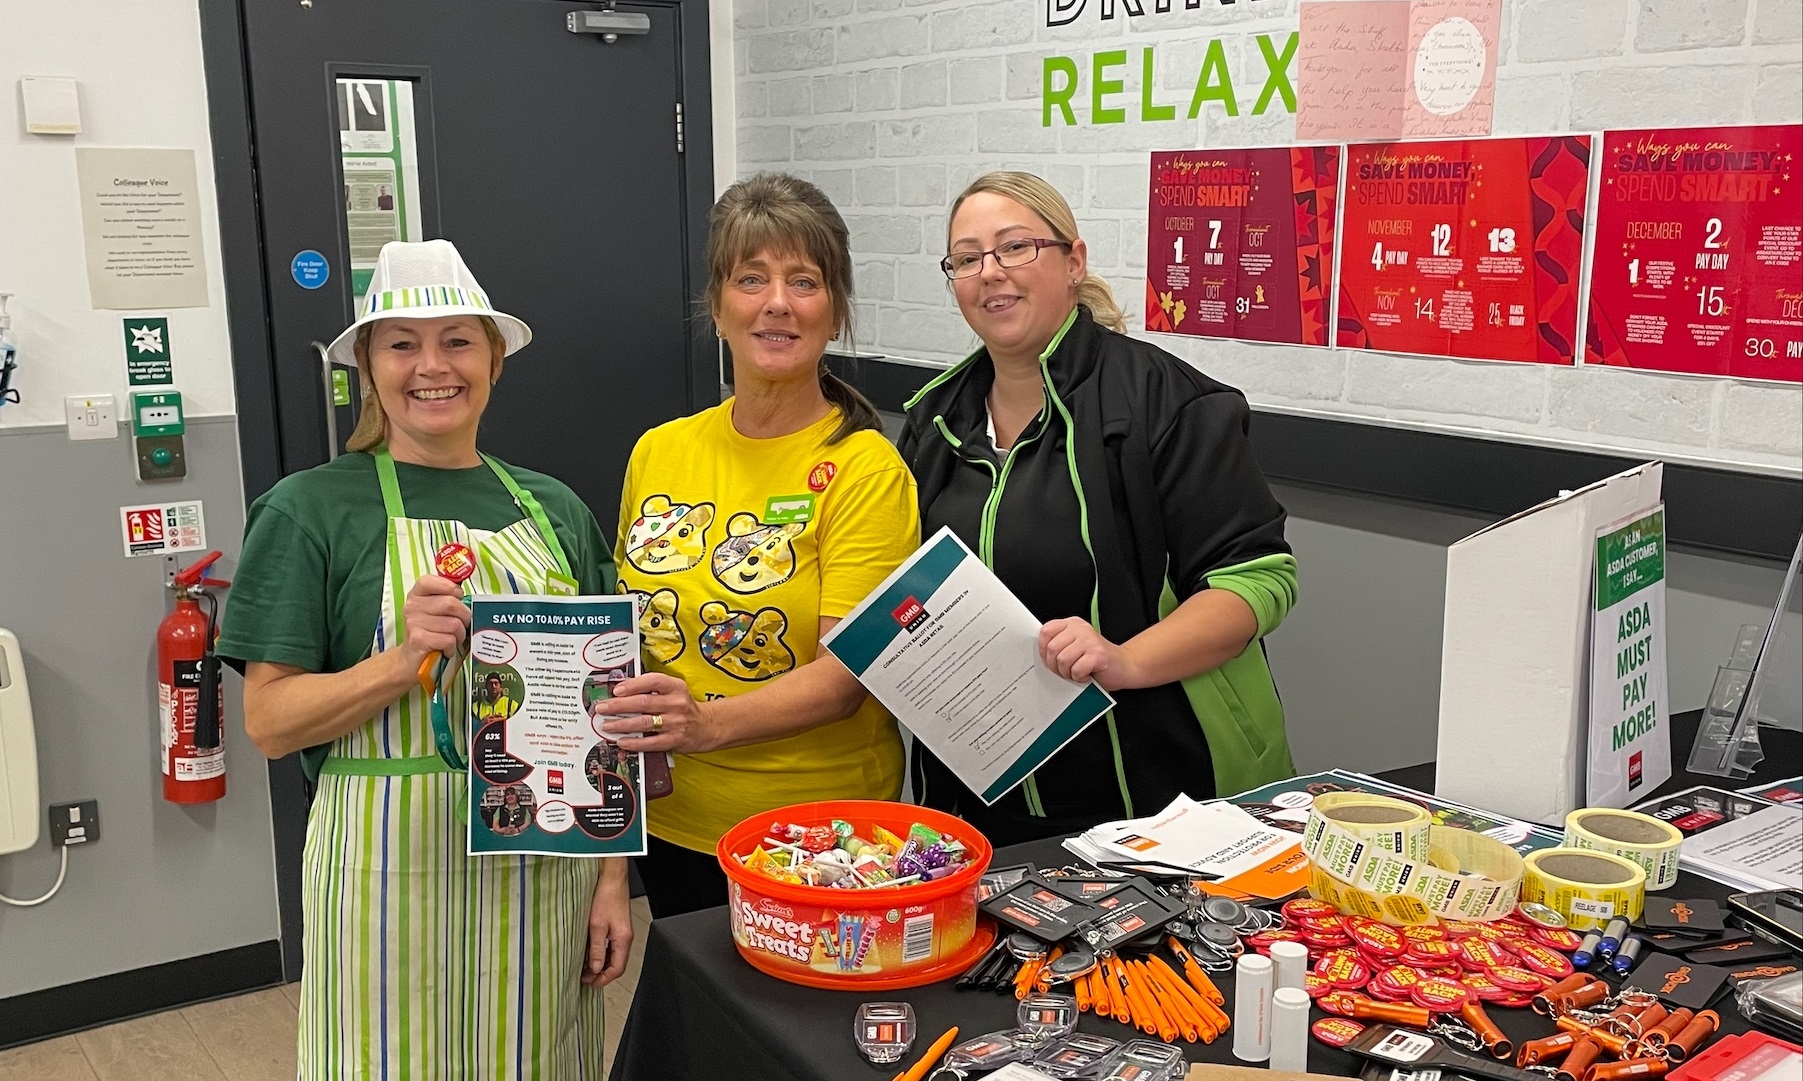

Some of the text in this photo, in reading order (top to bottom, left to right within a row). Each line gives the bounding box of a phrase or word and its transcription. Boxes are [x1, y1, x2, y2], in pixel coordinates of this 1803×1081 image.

[1042, 31, 1300, 127] RELAX
[1637, 134, 1732, 162] Ways you can
[1173, 154, 1228, 175] Ways you can
[1374, 147, 1444, 172] Ways you can
[1618, 151, 1781, 174] SAVE MONEY,
[1161, 169, 1196, 184] SAVE
[1360, 162, 1476, 182] SAVE MONEY,
[1160, 184, 1250, 207] SPEND SMART
[1358, 180, 1470, 205] SPEND SMART
[1616, 173, 1772, 202] SPEND SMART
[1164, 216, 1194, 231] OCTOBER
[1368, 220, 1412, 236] NOVEMBER
[1627, 222, 1682, 240] DECEMBER
[1248, 232, 1264, 247] OCT
[1431, 224, 1451, 256] 12
[1488, 228, 1516, 253] 13
[1204, 252, 1224, 266] PAY DAY
[1386, 250, 1396, 265] PAY
[1397, 251, 1408, 265] DAY
[1696, 254, 1729, 270] PAY DAY
[1206, 285, 1220, 299] OCT
[1696, 286, 1724, 316] 15
[1236, 296, 1250, 314] 31
[1377, 295, 1396, 310] NOV
[1414, 297, 1434, 320] 14
[1510, 304, 1524, 316] BLACK
[1508, 316, 1525, 327] FRIDAY
[1745, 338, 1803, 358] 30 PAY
[1624, 529, 1641, 550] AS AN
[1606, 541, 1659, 578] ASDA CUSTOMER,
[492, 614, 611, 626] SAY NO TO A 0% PAY RISE
[900, 604, 920, 623] GMB
[909, 613, 927, 630] UNION
[1617, 601, 1651, 644] ASDA
[883, 641, 913, 669] CONSULTATIVE
[912, 628, 928, 643] BALLOT
[926, 621, 936, 631] FOR
[944, 594, 964, 613] MEMBERS
[919, 624, 945, 648] ASDA RETAIL
[1617, 636, 1652, 680] MUST
[1623, 672, 1648, 711] PAY
[1613, 700, 1656, 752] MORE!
[1630, 761, 1641, 775] GMB
[1652, 804, 1692, 821] GMB
[1232, 831, 1265, 848] SUPPORT
[1261, 833, 1277, 843] FOR
[1322, 834, 1336, 860] ASDA
[1250, 844, 1270, 856] NOW
[1330, 834, 1348, 870] MUST PAY
[1335, 838, 1355, 874] MORE!
[1188, 854, 1216, 868] ADVICE
[1363, 857, 1380, 882] ASDA
[1385, 857, 1394, 872] PAY
[1346, 865, 1354, 878] GMB
[1430, 877, 1452, 911] MORE!
[1459, 888, 1475, 912] ASDA
[1441, 900, 1450, 913] GMB
[742, 901, 814, 943] Sweet
[745, 926, 811, 962] Treats
[1363, 937, 1385, 950] ASDA
[1468, 936, 1496, 966] ROLLING
[1417, 981, 1467, 996] ROLLING
[1432, 977, 1456, 985] ASDA
[1422, 985, 1456, 999] BACK
